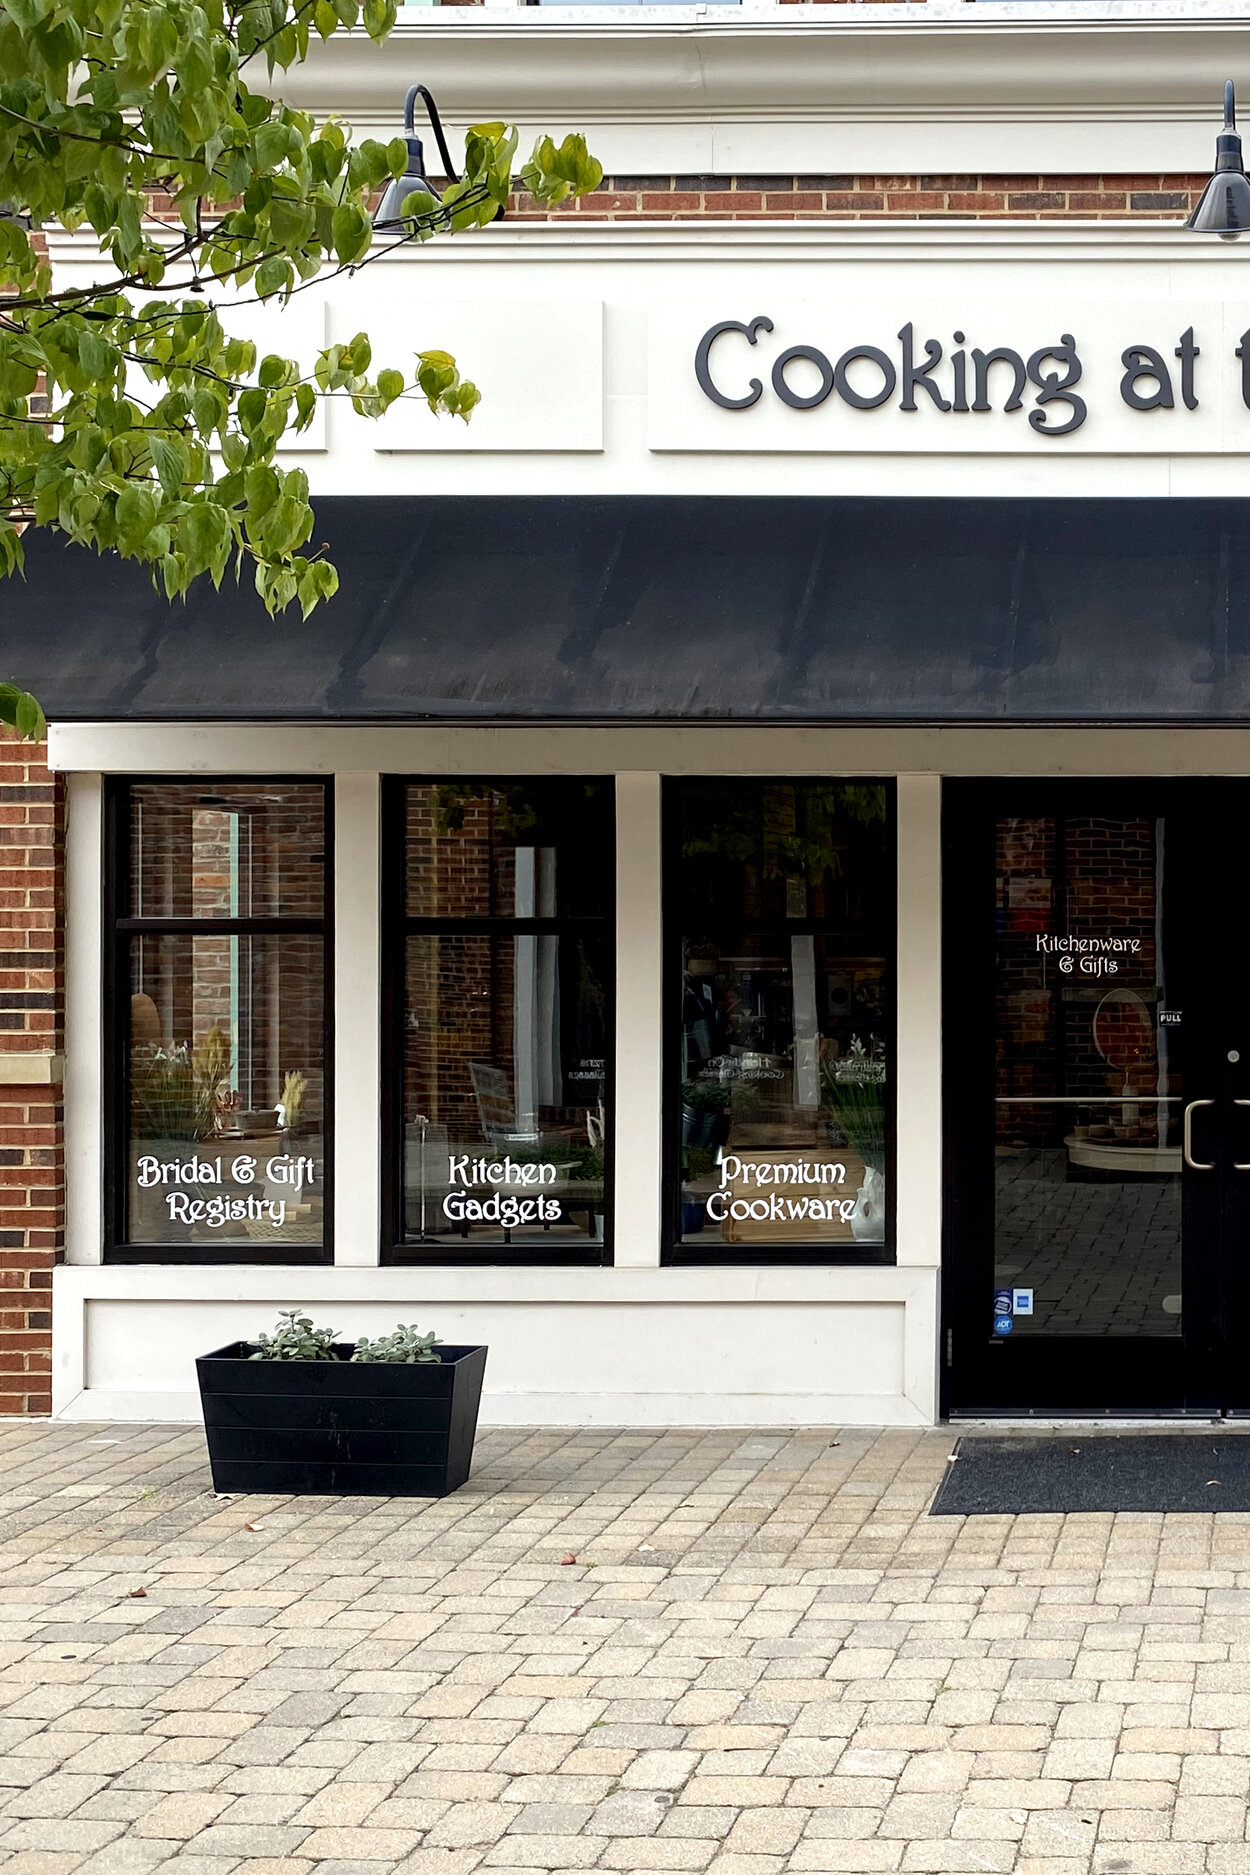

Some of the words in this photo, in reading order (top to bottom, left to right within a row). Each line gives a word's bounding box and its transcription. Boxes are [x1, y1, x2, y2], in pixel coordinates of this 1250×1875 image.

[695, 316, 1087, 437] Cooking
[1120, 327, 1200, 412] at
[1037, 934, 1140, 953] Kitchenware
[1059, 956, 1073, 972] &
[1080, 956, 1118, 977] Gifts
[1160, 1014, 1181, 1023] PULL
[138, 1156, 222, 1187] Bridal
[232, 1156, 256, 1183] &
[266, 1154, 314, 1191] Gift
[449, 1155, 556, 1187] Kitchen
[717, 1154, 846, 1188] Premium
[166, 1192, 285, 1227] Registry
[443, 1191, 561, 1227] Gadgets
[706, 1192, 856, 1222] Cookware
